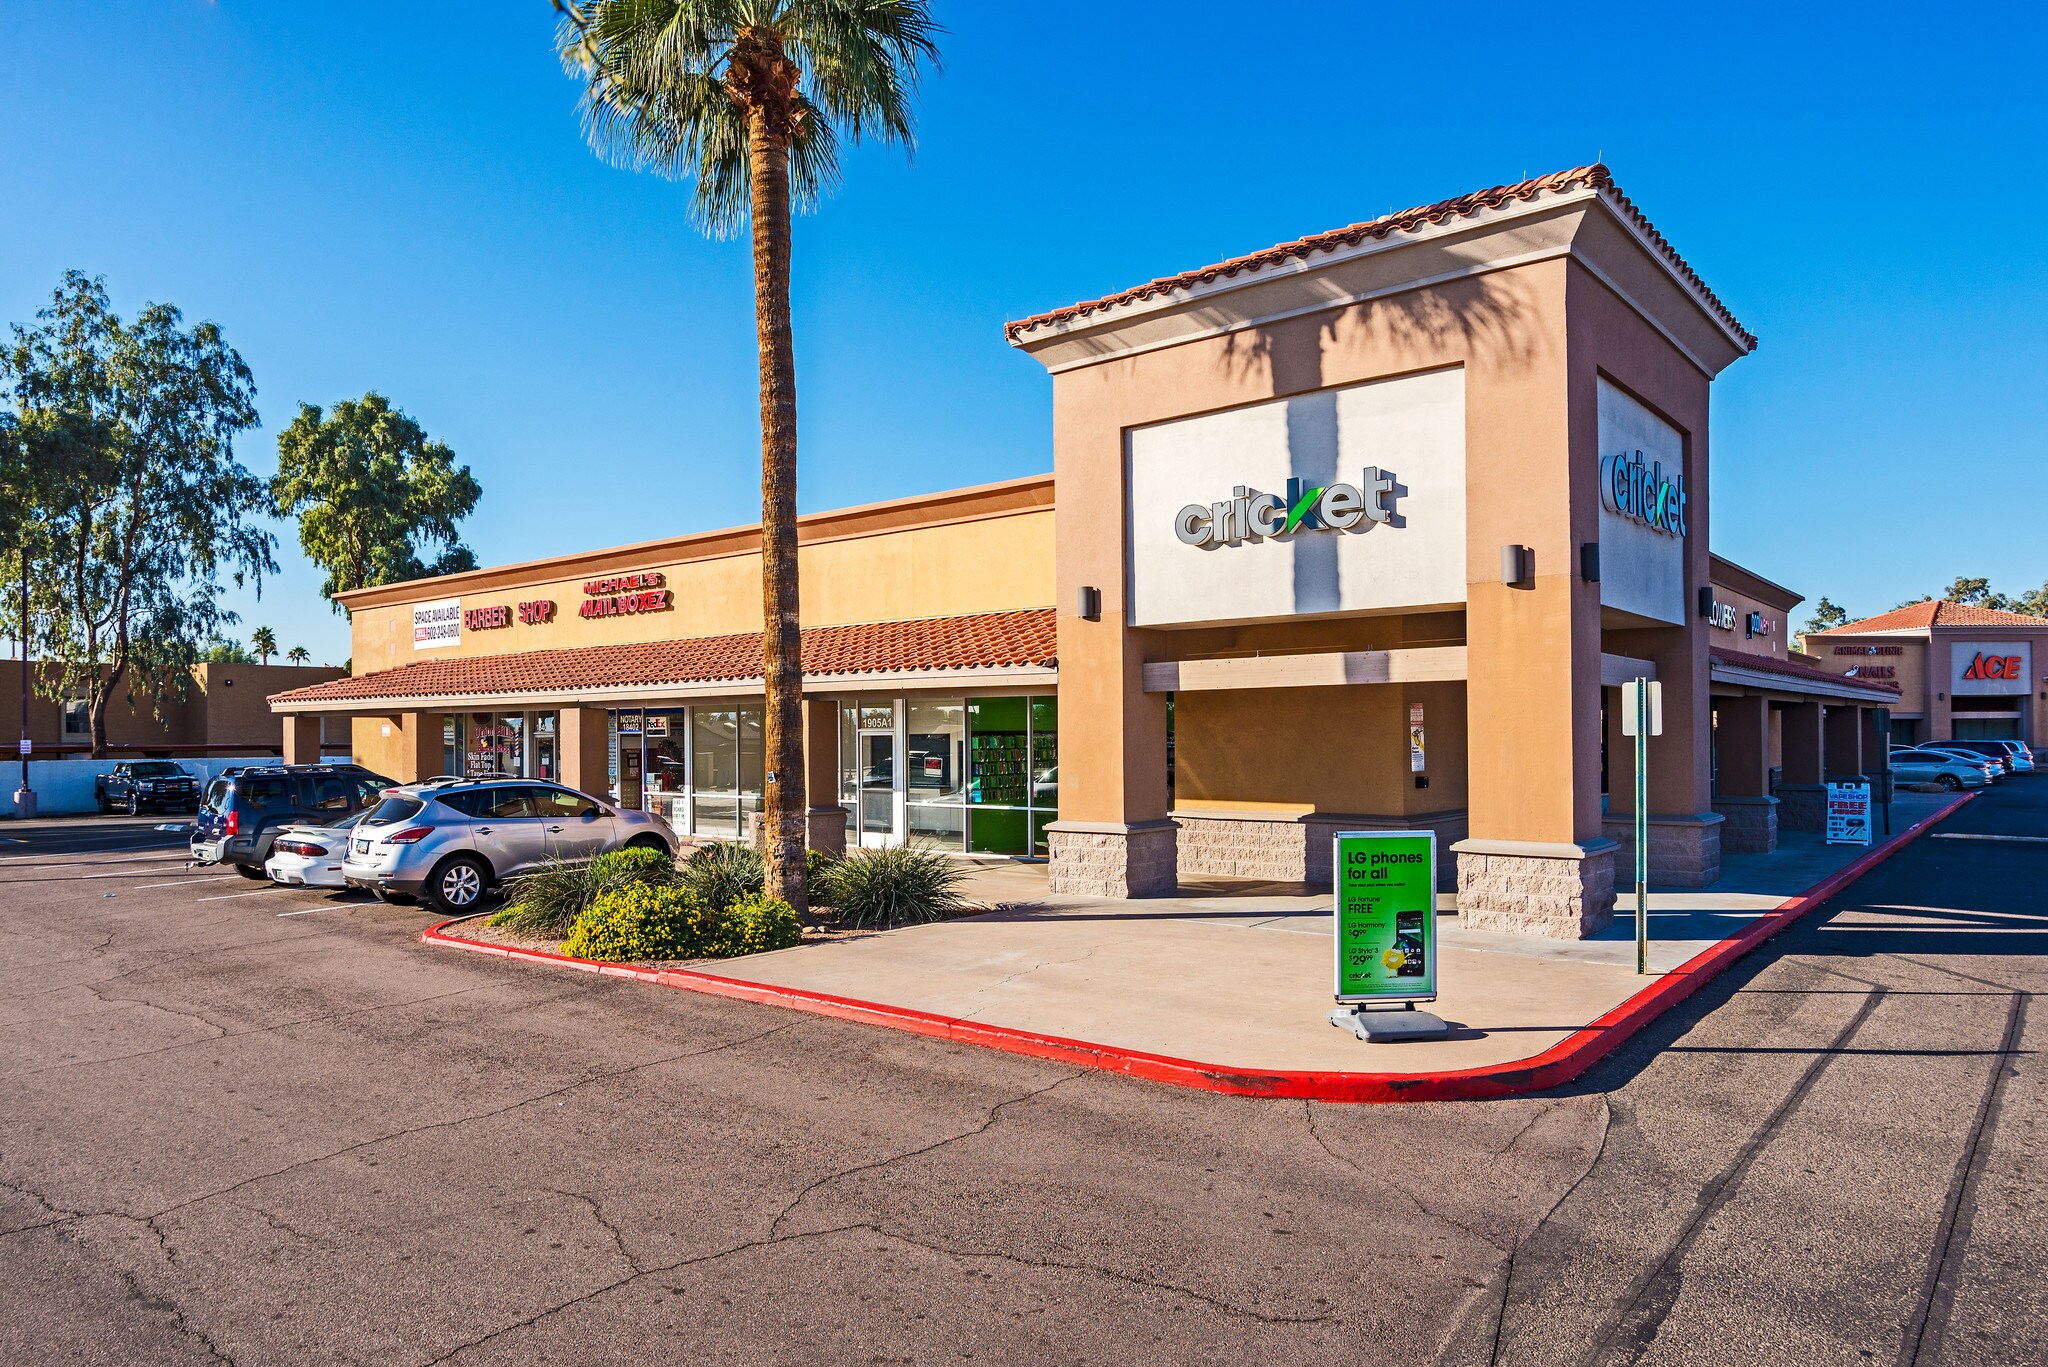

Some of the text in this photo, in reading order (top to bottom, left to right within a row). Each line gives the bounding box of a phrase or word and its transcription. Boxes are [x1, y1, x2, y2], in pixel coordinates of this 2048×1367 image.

[1601, 449, 1687, 538] cricket
[1174, 465, 1393, 546] cricket
[583, 572, 658, 593] MICHAEL'S
[578, 589, 666, 617] MAIL BOXEZ
[414, 605, 460, 625] SPACE AVAILABLE
[463, 599, 549, 629] BARBER SHOP
[1834, 646, 1867, 656] ANIMAL
[1858, 665, 1896, 679] NAILS
[1963, 651, 2022, 680] ACE
[620, 715, 643, 724] NOTARY
[646, 718, 665, 728] FedEx
[863, 718, 892, 728] 1905A1
[467, 752, 480, 761] Skin
[470, 761, 492, 771] Flat Top
[1829, 801, 1867, 809] FREE
[1348, 852, 1423, 866] LG phones
[1348, 867, 1388, 880] for all
[1348, 904, 1373, 914] FREE
